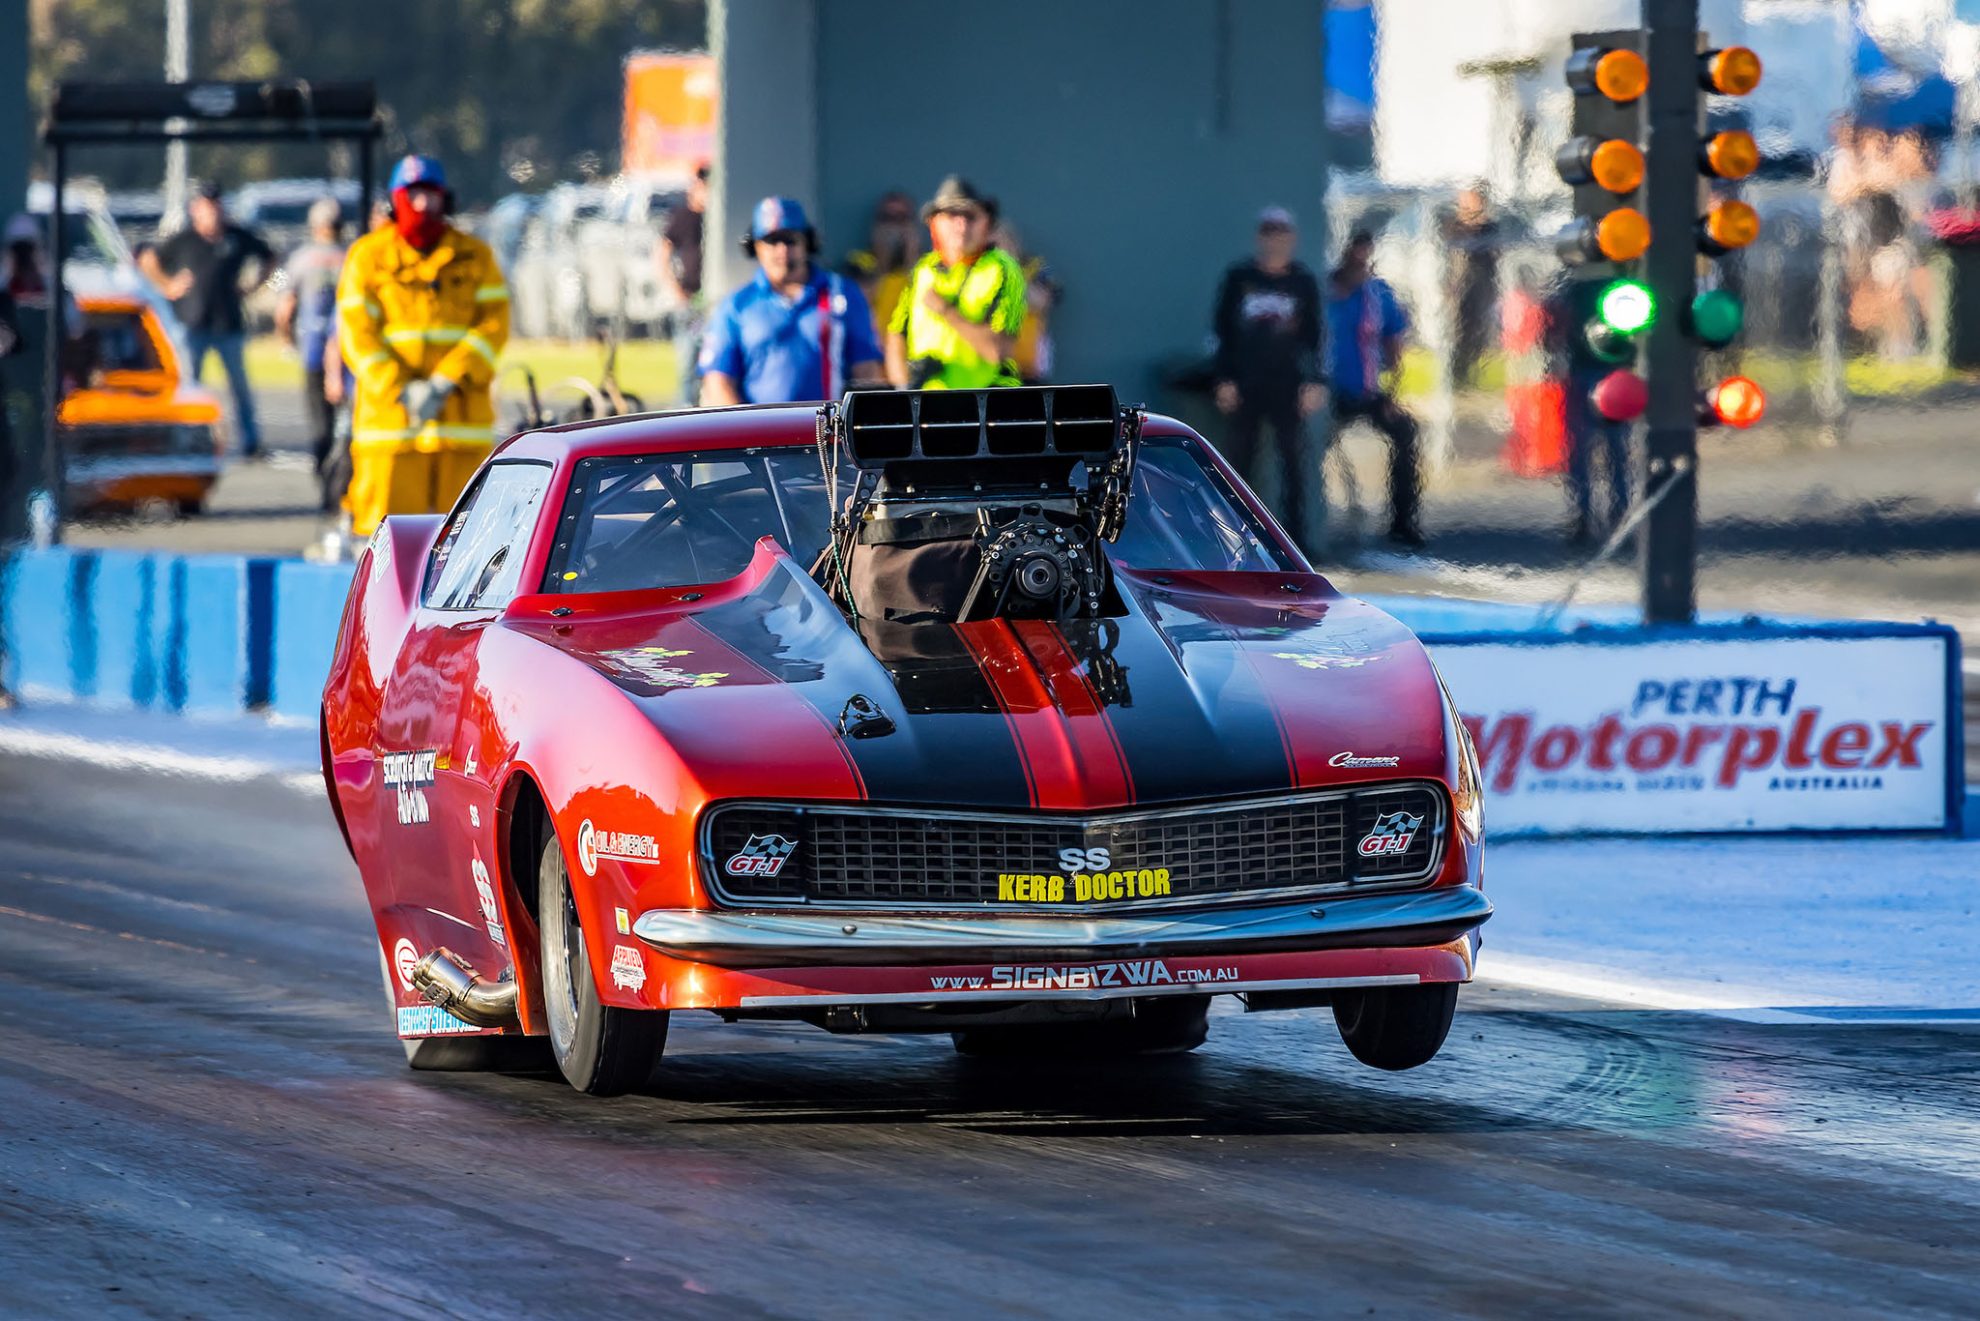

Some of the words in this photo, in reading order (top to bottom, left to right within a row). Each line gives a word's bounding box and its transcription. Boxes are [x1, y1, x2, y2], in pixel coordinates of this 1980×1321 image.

[1630, 677, 1796, 718] PERTH
[1328, 751, 1400, 768] Camaro
[1461, 705, 1936, 794] Motorplex
[1768, 775, 1883, 791] AUSTRALIA
[1360, 834, 1412, 855] GT-1
[728, 855, 783, 876] GT-1
[1059, 847, 1111, 871] SS
[998, 873, 1065, 902] KERB
[1075, 867, 1171, 902] DOCTOR
